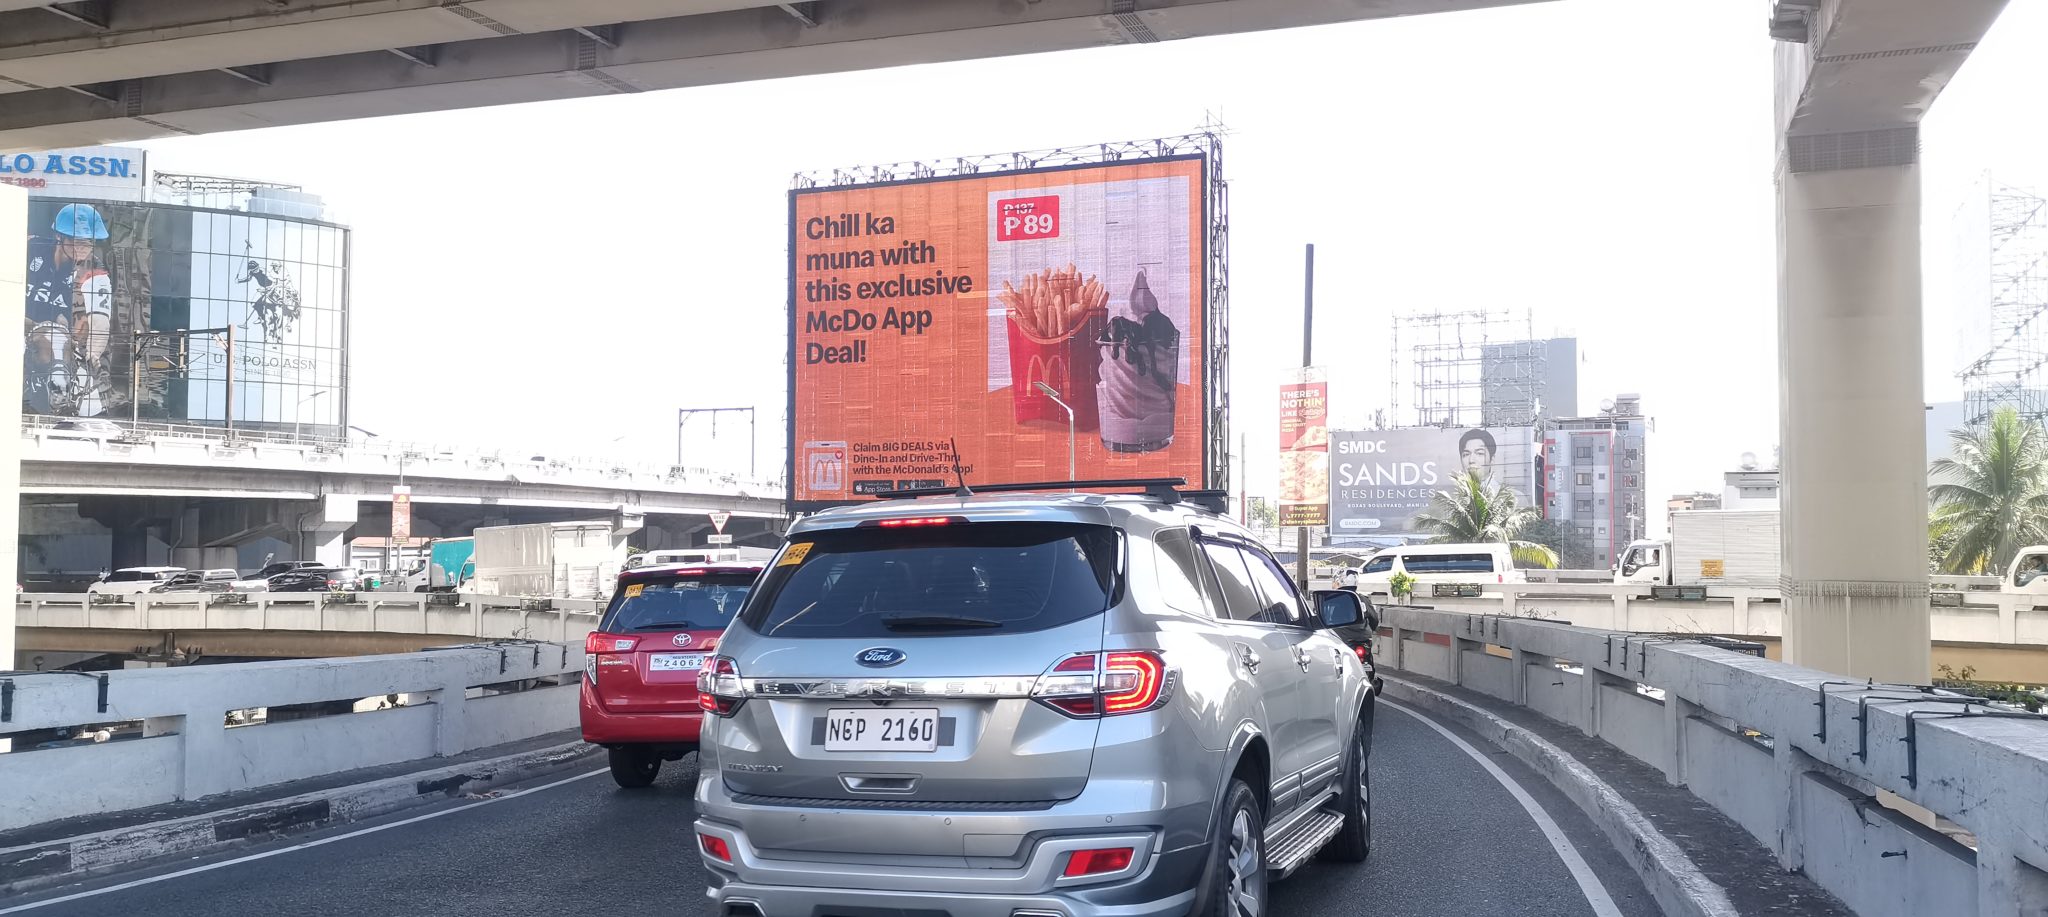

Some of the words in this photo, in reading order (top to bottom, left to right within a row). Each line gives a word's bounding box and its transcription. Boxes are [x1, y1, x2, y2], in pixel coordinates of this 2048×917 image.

[43, 154, 137, 178] ASSN.
[806, 213, 860, 240] Chill
[865, 212, 895, 236] ka
[806, 249, 875, 271] muna
[880, 240, 936, 266] with
[805, 276, 852, 303] this
[856, 270, 973, 300] exclusive
[805, 309, 877, 334] McDo
[881, 306, 933, 336] App
[806, 339, 866, 365] Deal!
[243, 355, 279, 367] POLO
[1281, 389, 1320, 399] THERE'S
[1281, 397, 1325, 409] NOTHIN'
[853, 442, 881, 452] Claim
[882, 442, 899, 451] BIG
[901, 441, 934, 451] DEALS
[935, 441, 950, 451] via
[1338, 440, 1386, 454] SMDC
[853, 453, 888, 463] Dine-In
[889, 453, 908, 463] and
[853, 465, 875, 475] with
[875, 465, 891, 475] the
[892, 464, 949, 475] McDonald's
[1338, 461, 1438, 487] SANDS
[1341, 488, 1436, 500] RESIDENCES
[864, 650, 894, 661] Ford
[762, 680, 998, 696] EVEREST
[881, 718, 934, 741] 2160
